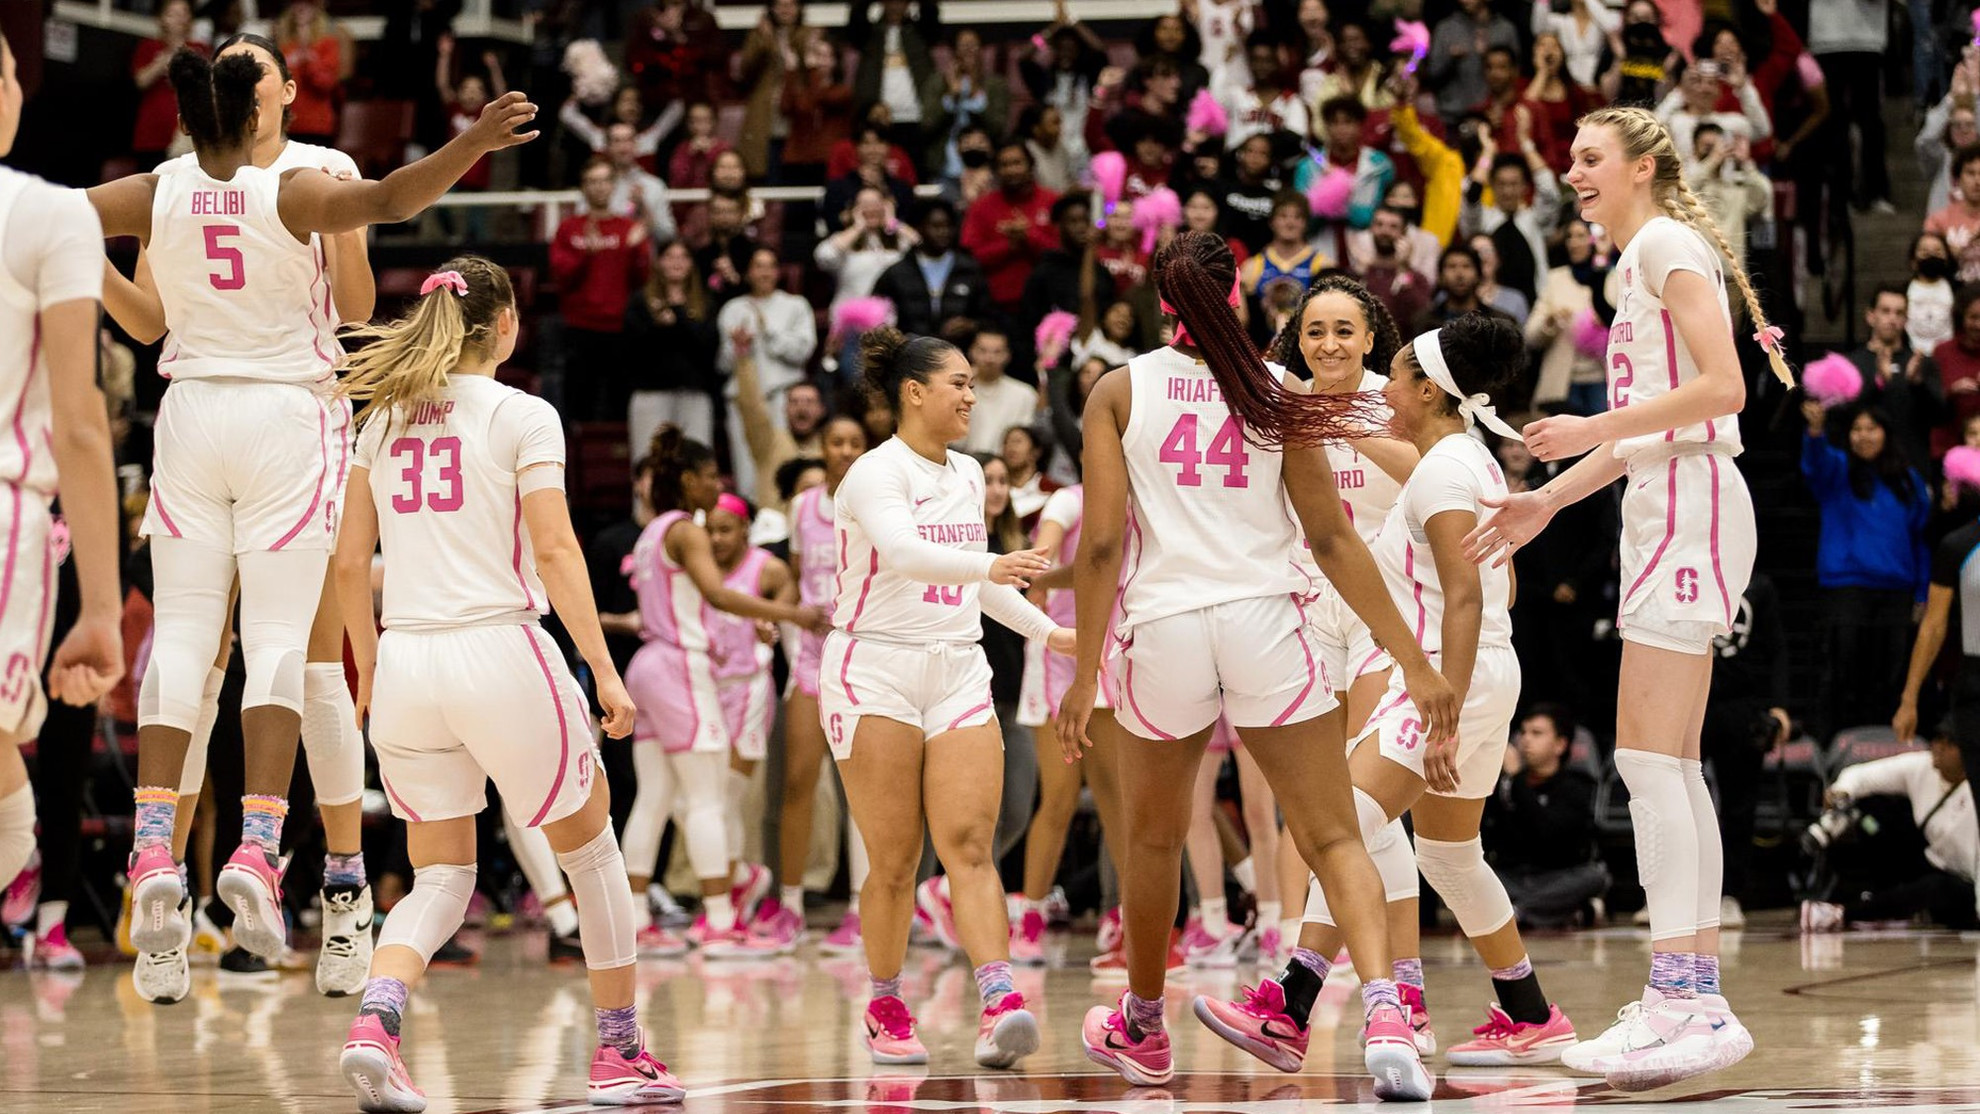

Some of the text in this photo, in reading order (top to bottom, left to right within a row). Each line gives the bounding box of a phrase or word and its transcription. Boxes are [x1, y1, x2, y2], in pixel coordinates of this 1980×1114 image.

[191, 190, 245, 215] BELIBI
[202, 225, 246, 290] 5
[390, 436, 464, 514] 33
[1159, 412, 1249, 489] 44
